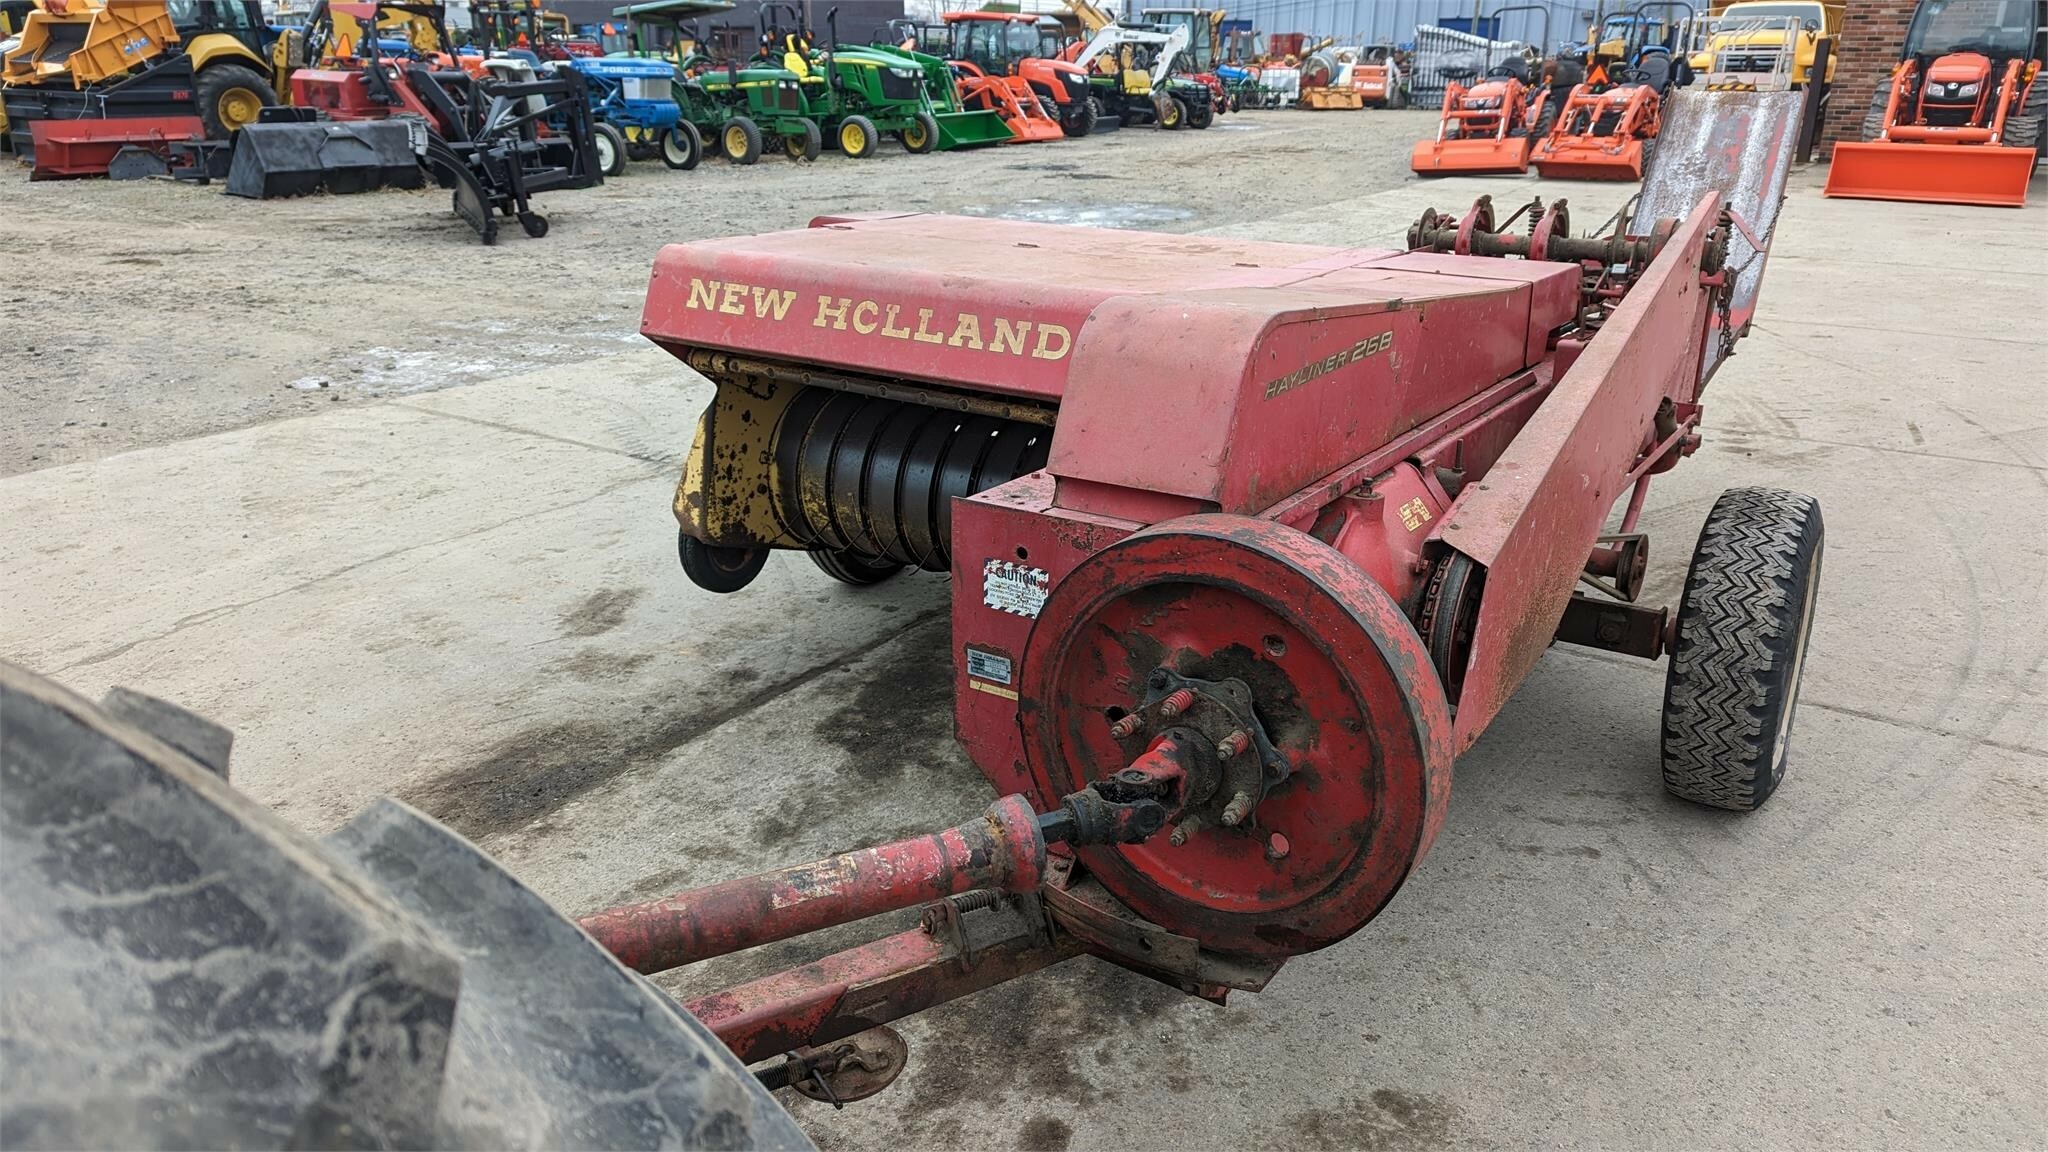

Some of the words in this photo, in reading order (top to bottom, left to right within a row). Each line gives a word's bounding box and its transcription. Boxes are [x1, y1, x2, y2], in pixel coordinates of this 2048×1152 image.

[686, 278, 795, 322] NEW
[813, 295, 1071, 360] HOLLAND
[1264, 351, 1347, 400] HAYLINER
[1351, 330, 1393, 362] 268
[996, 567, 1037, 586] CAUTION
